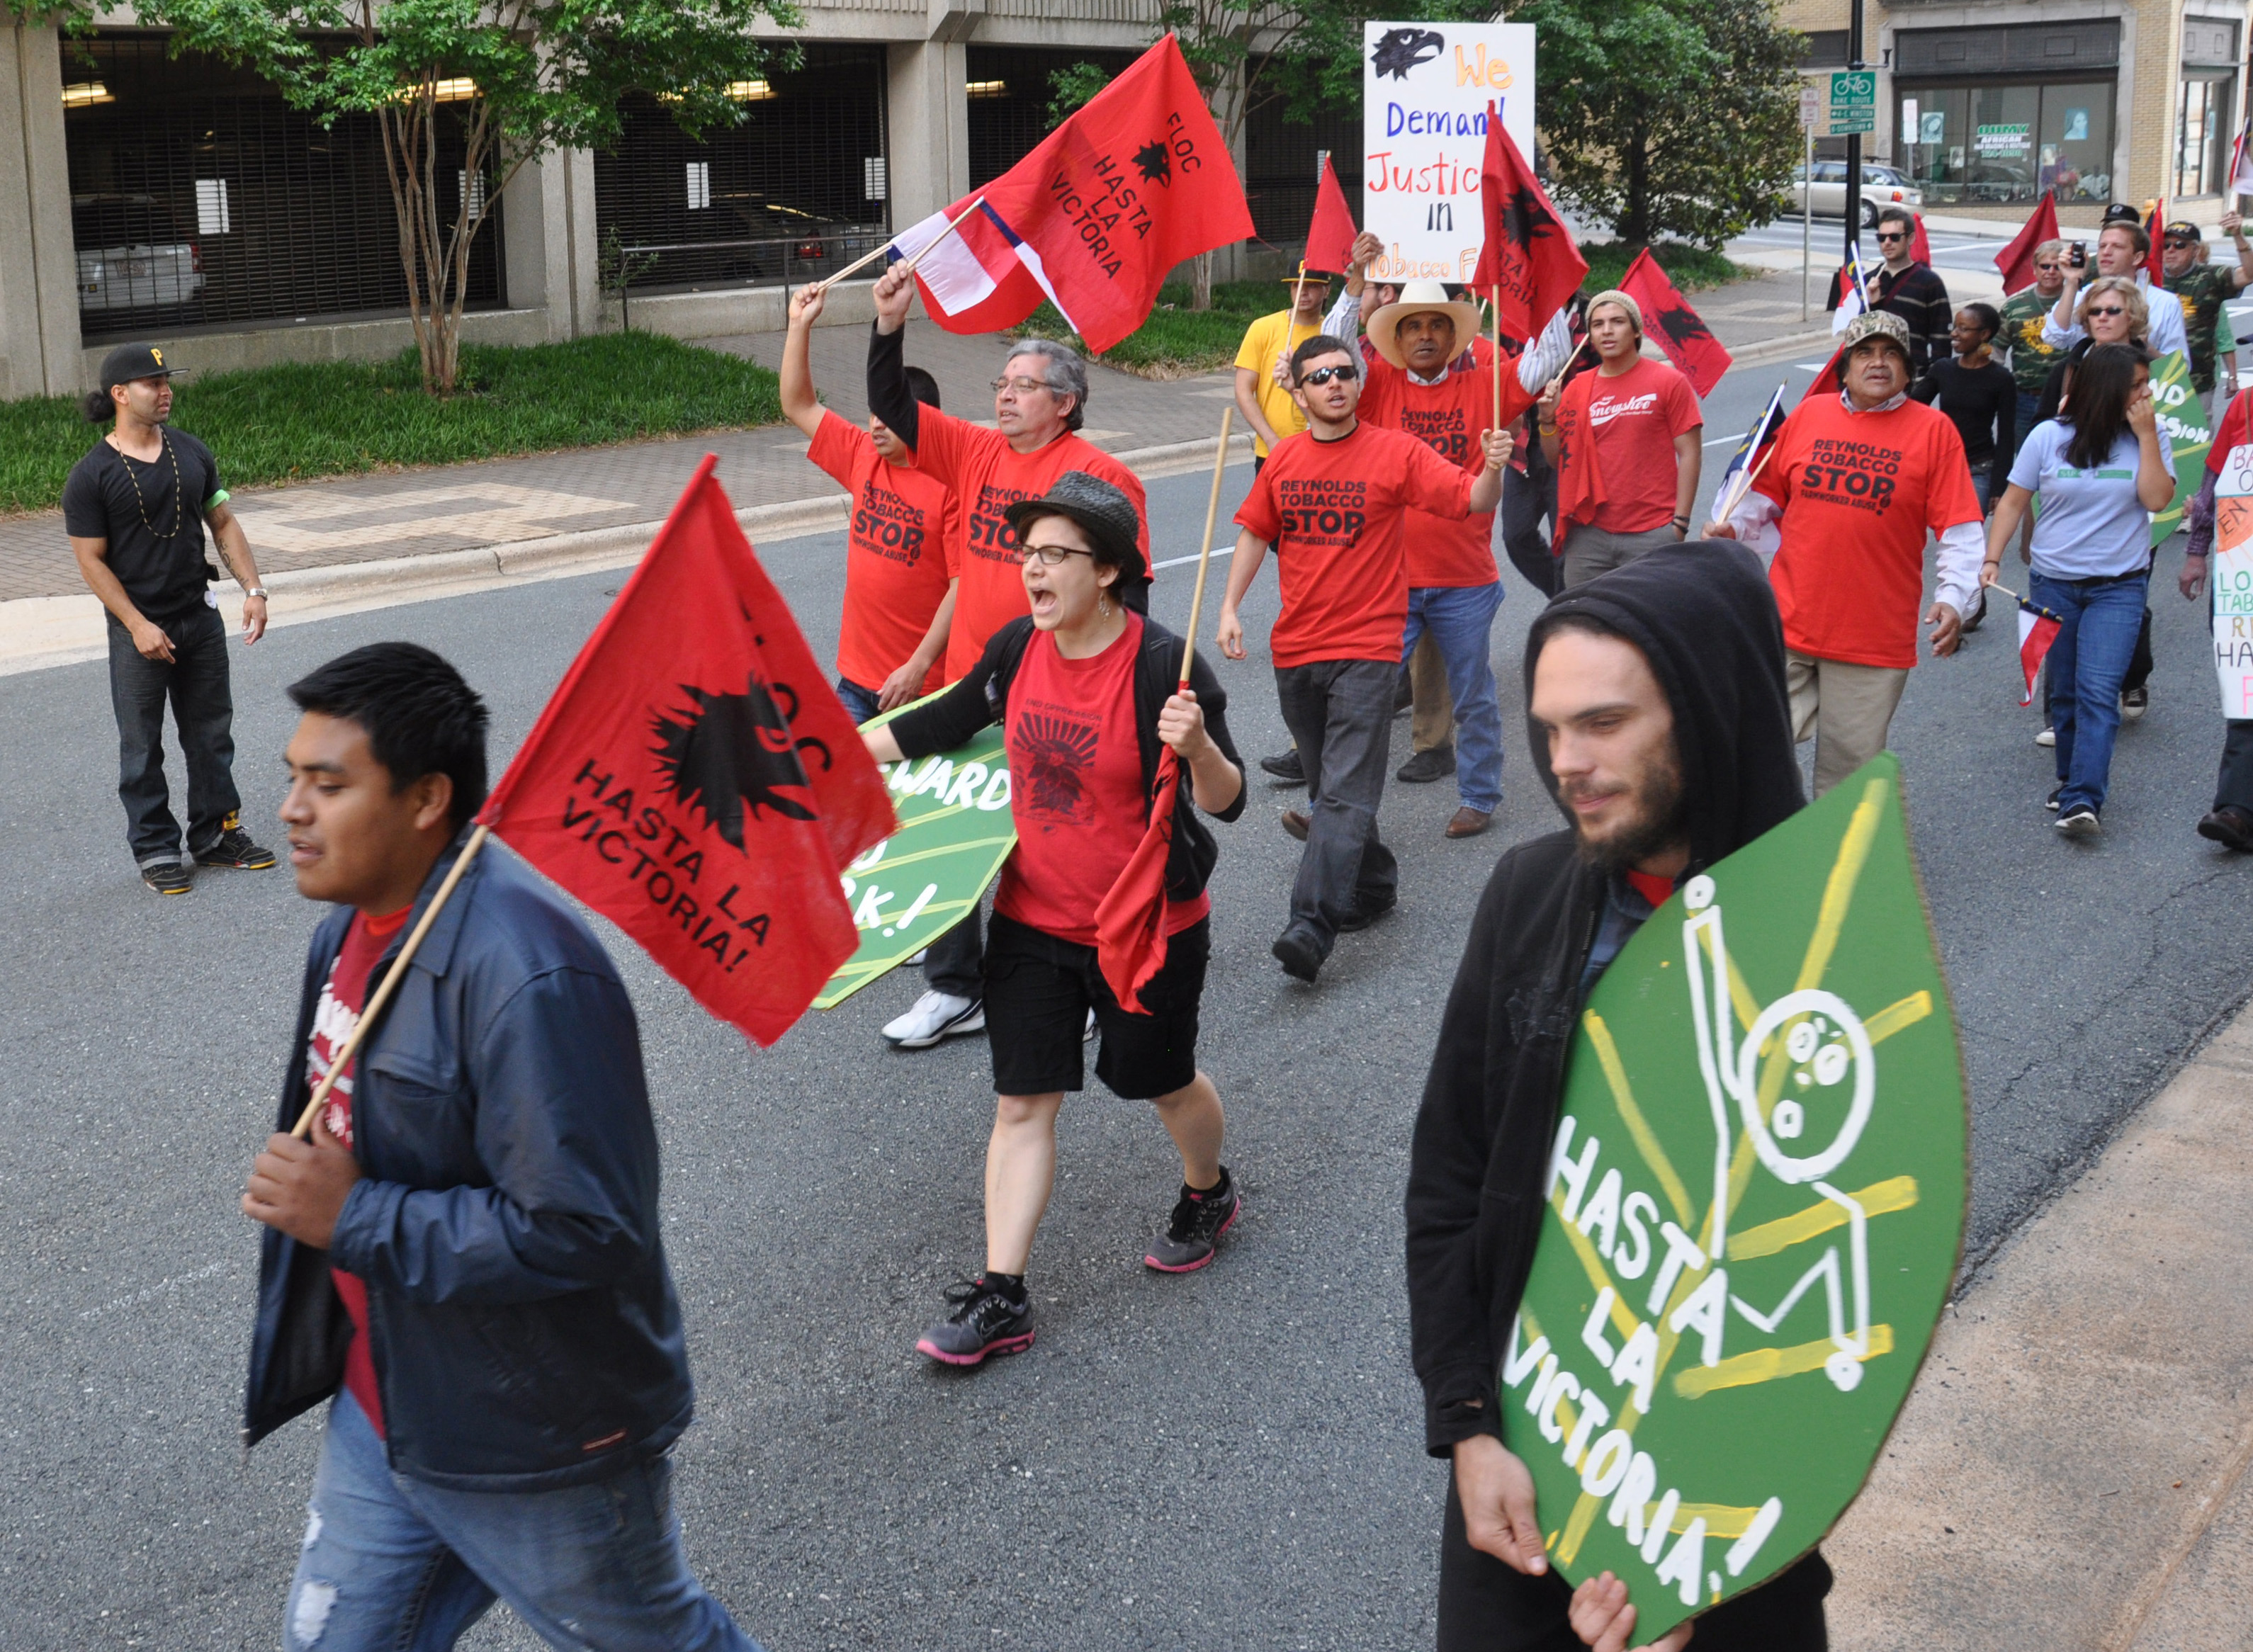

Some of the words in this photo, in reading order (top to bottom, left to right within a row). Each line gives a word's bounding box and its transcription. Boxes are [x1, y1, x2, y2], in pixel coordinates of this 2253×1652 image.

[1455, 43, 1513, 89] We
[1833, 96, 1848, 105] BIKE
[1851, 96, 1871, 104] ROUTE
[1167, 111, 1201, 174] FLOC
[1367, 152, 1479, 195] Justic
[1091, 195, 1122, 232] LA
[1093, 154, 1153, 240] HASTA
[1051, 171, 1123, 280] VICTORIA
[150, 348, 164, 366] P
[2147, 378, 2186, 407] ND
[1401, 417, 1466, 434] TOBACCO
[1812, 451, 1899, 475] TOBACCO
[1813, 439, 1902, 462] REYNOLDS
[1280, 480, 1367, 493] REYNOLDS
[1801, 464, 1896, 499] STOP
[1280, 494, 1366, 509] TOBACCO
[970, 513, 1021, 550] STO
[1281, 510, 1366, 534] STOP
[879, 755, 1011, 810] WARD
[573, 758, 704, 884] HASTA
[716, 884, 775, 947] LA
[563, 797, 750, 973] VICTORIA!
[1545, 1115, 1727, 1368] HASTA
[1582, 1285, 1659, 1414] LA
[1501, 1311, 1783, 1606] VICTORIA!
